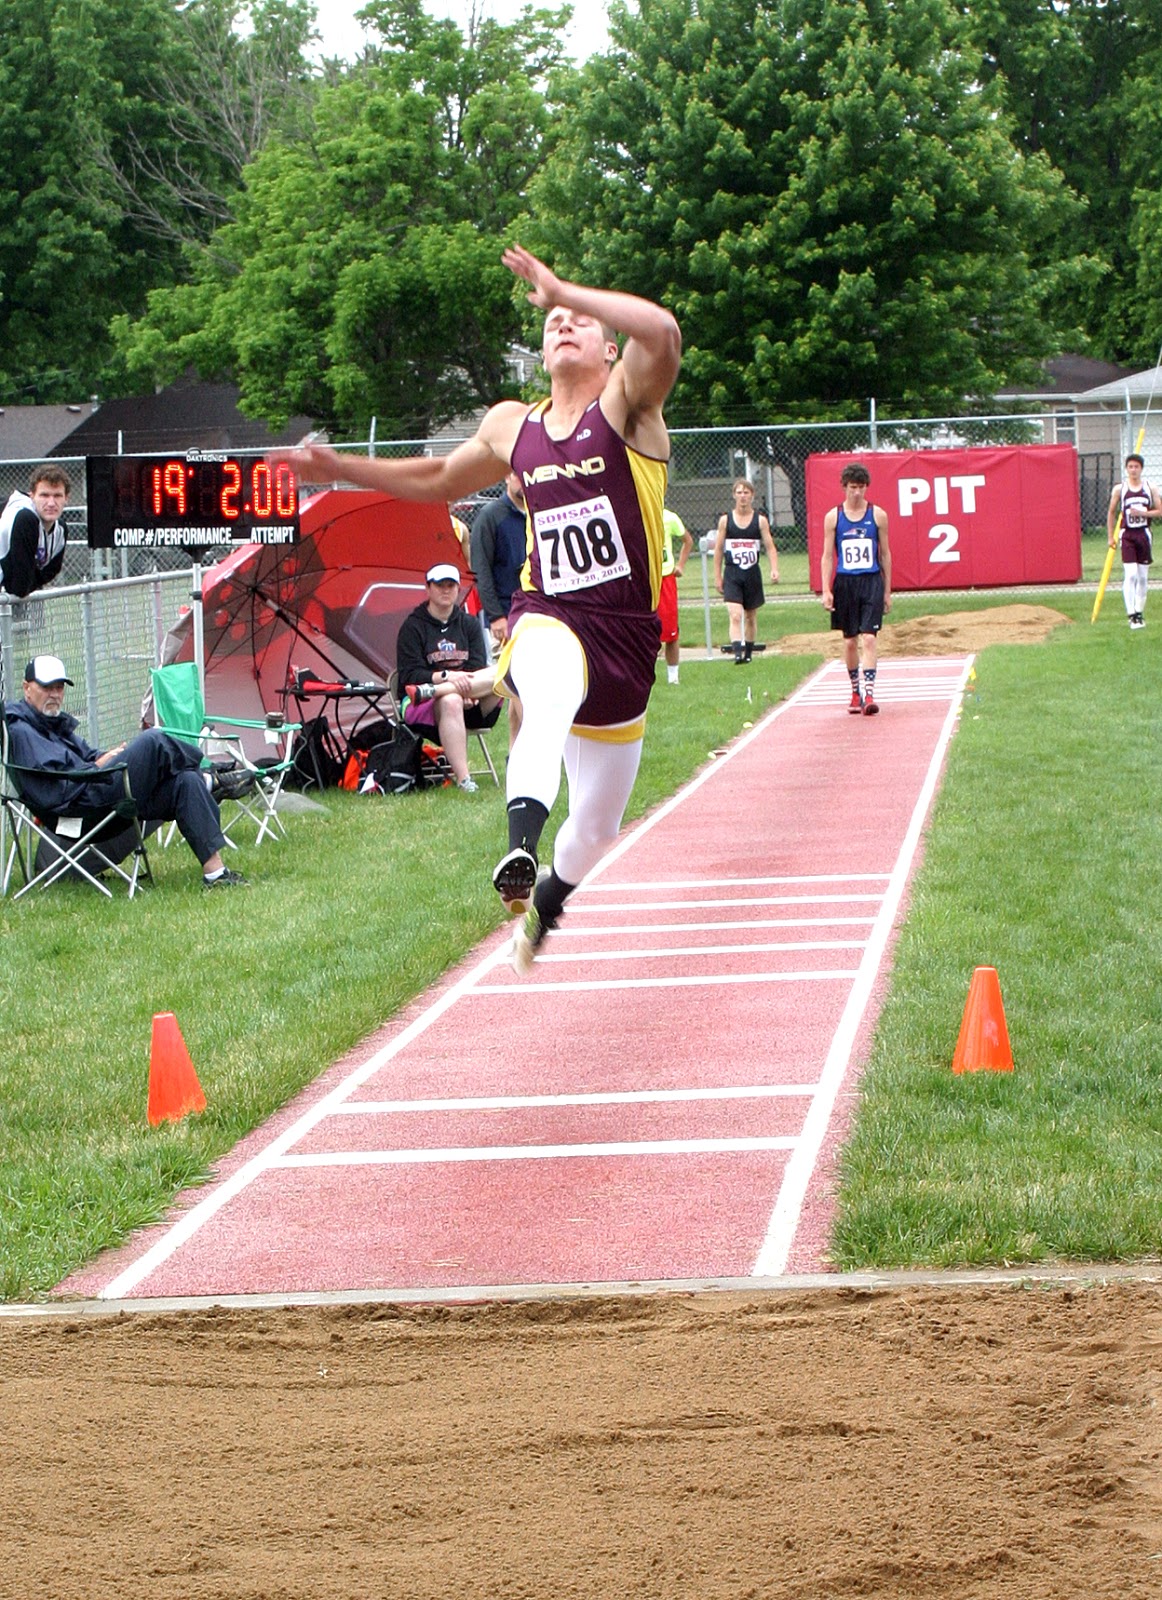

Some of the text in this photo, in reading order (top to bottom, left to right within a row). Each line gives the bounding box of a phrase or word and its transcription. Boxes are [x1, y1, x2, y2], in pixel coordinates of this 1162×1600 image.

[186, 454, 228, 462] DAKTRONICS
[522, 456, 606, 487] MENNO
[221, 462, 297, 518] 2.00
[897, 475, 986, 516] PIT
[537, 503, 605, 526] SDHSAA
[250, 526, 294, 544] ATTEMPT
[928, 524, 960, 563] 2
[540, 518, 618, 580] 708
[734, 550, 756, 566] 550
[844, 546, 870, 564] 634
